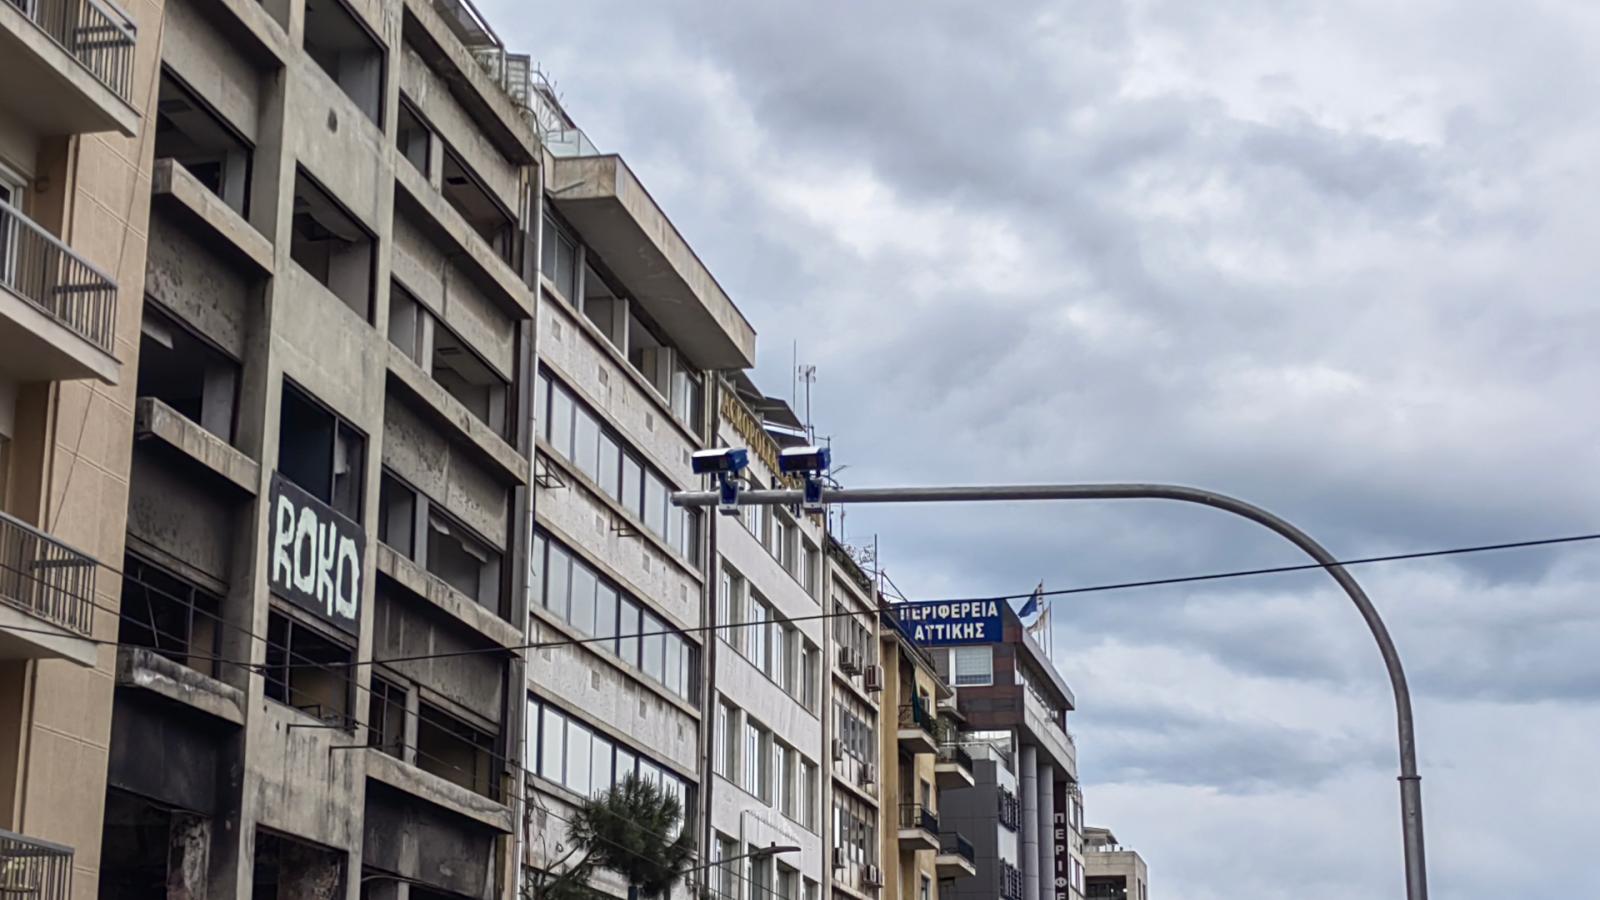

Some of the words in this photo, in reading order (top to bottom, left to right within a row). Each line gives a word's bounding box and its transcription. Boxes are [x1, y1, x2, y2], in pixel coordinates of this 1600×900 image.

[273, 494, 360, 619] ROKO
[900, 601, 998, 620] ΠΕΡΙΦΕΡΕΙΑ
[914, 623, 985, 641] ΑΤΤΙΚΗΣ
